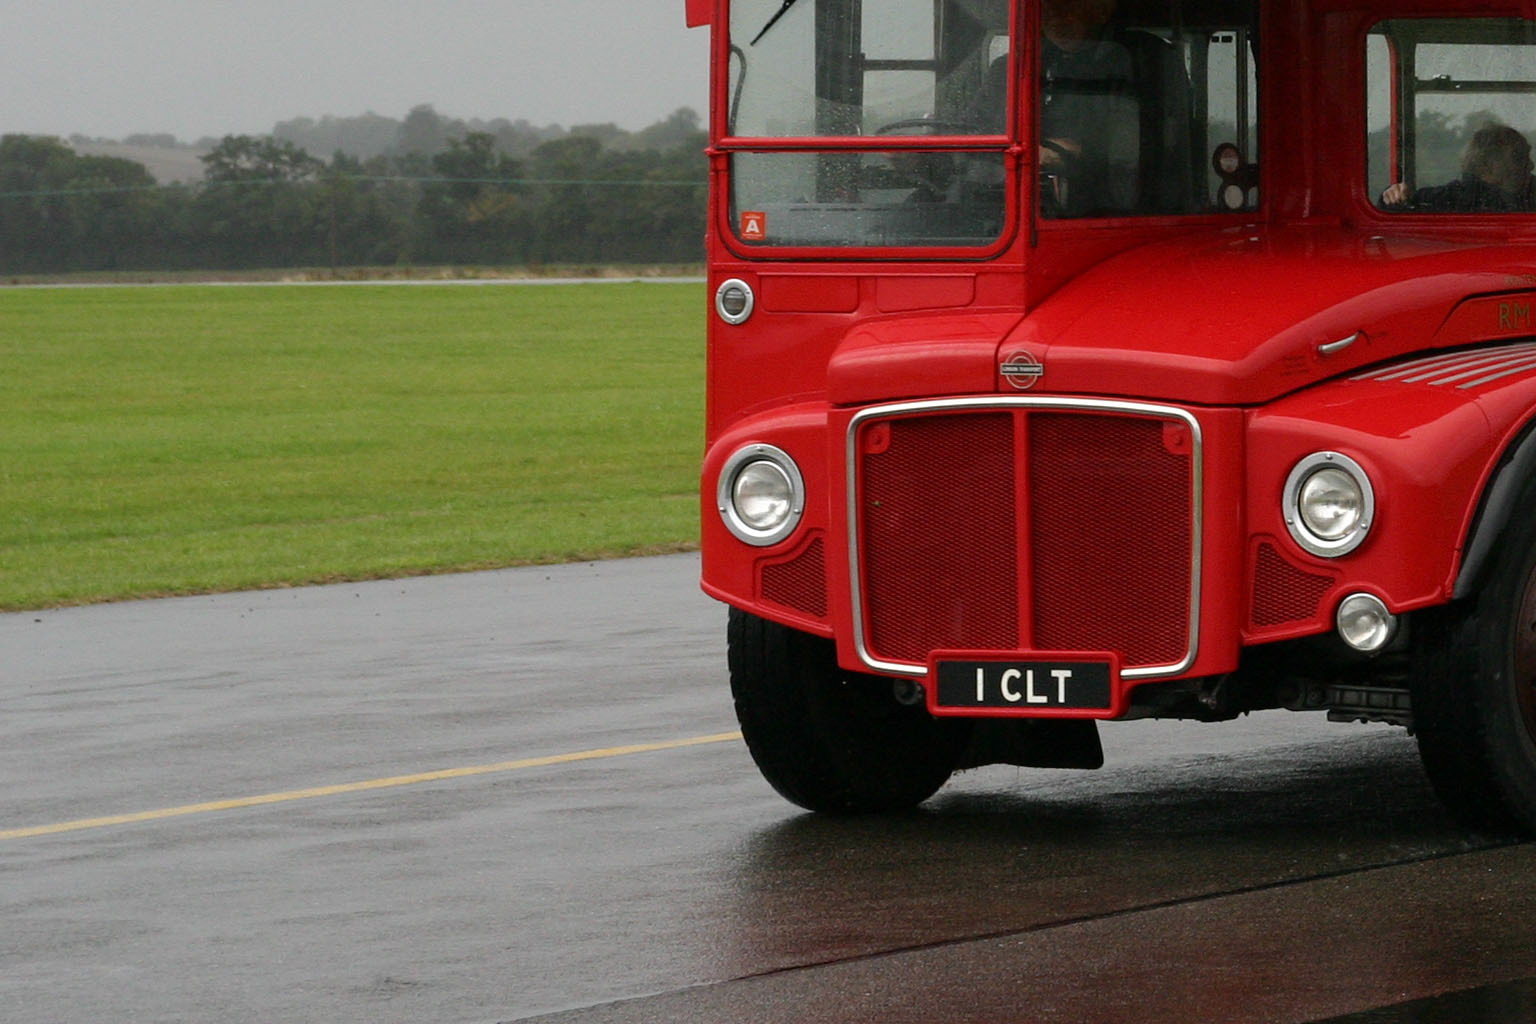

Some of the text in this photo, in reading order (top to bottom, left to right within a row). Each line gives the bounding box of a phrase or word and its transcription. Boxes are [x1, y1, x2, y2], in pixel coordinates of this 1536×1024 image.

[745, 219, 760, 233] A
[1499, 302, 1531, 331] RM
[1000, 668, 1072, 703] CLT
